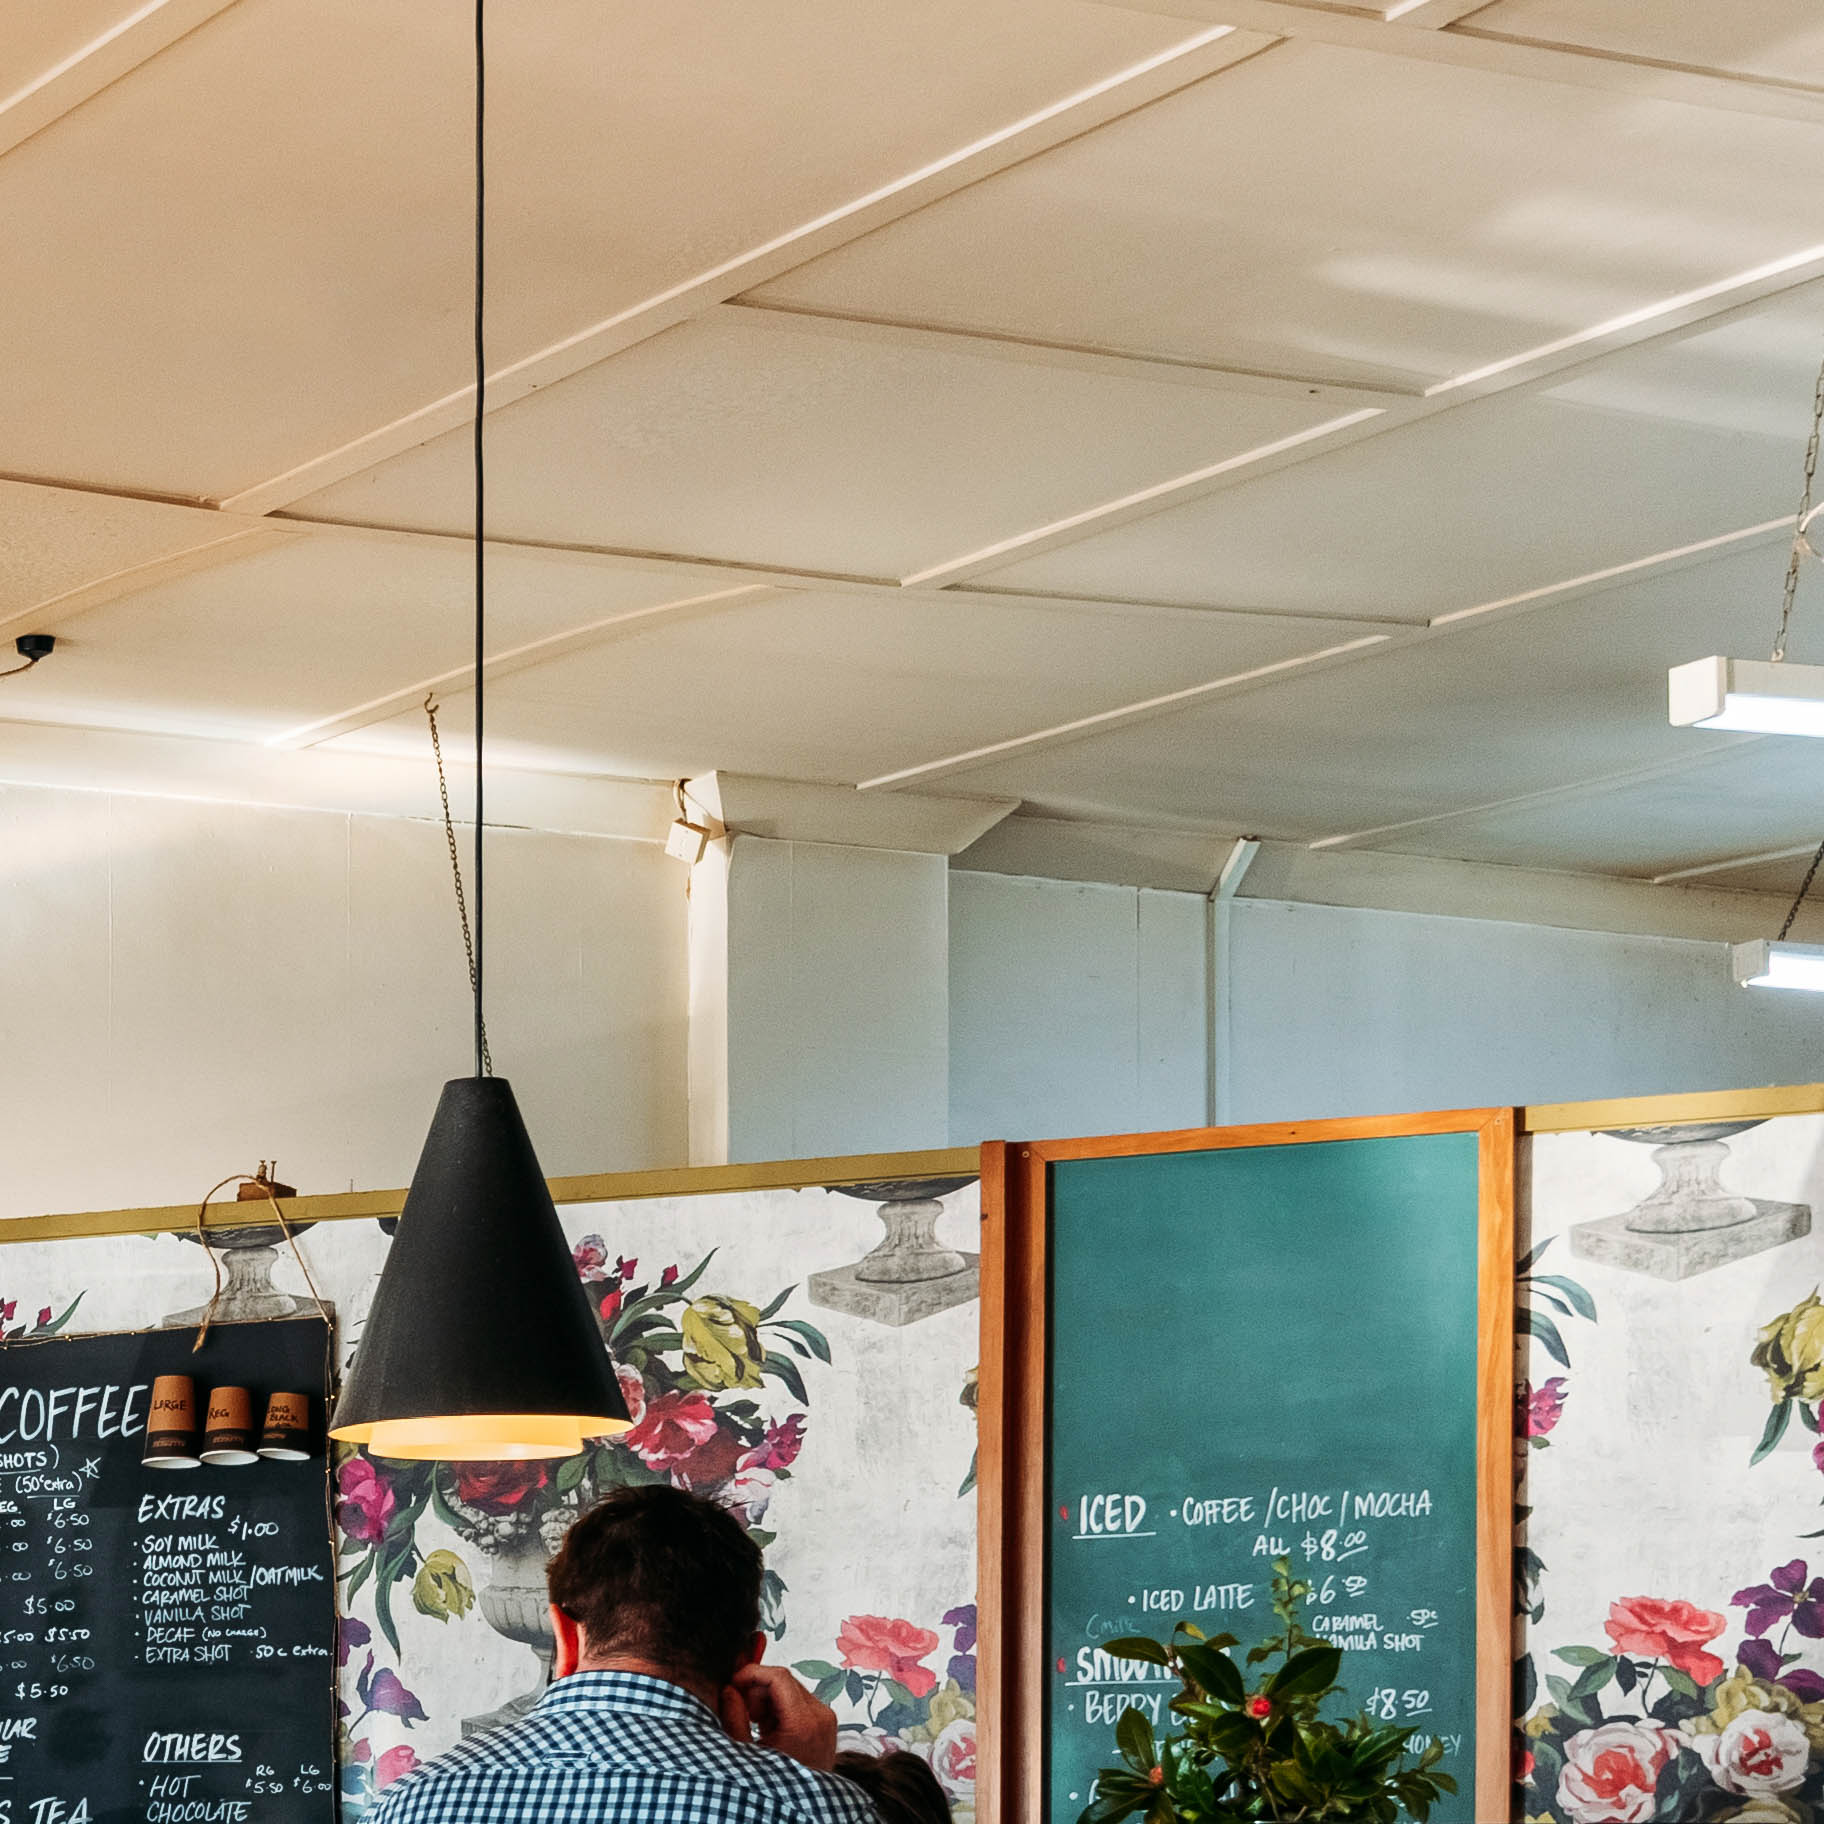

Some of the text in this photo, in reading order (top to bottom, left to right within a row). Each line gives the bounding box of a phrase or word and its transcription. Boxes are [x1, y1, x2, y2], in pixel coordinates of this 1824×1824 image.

[53, 1498, 76, 1510] LG
[138, 1494, 226, 1522] EXTRAS
[1078, 1490, 1432, 1533] ICED COFFEE MOCHA
[228, 1515, 280, 1540] $1.00
[142, 1534, 219, 1553] SOY MILK
[1252, 1534, 1290, 1555] ALL
[144, 1554, 202, 1570] ALMOND
[144, 1570, 205, 1587] COCONUT
[23, 1595, 76, 1616] $5.00
[142, 1587, 210, 1605] CARAMEL
[1142, 1584, 1254, 1610] ICED LATTE
[145, 1606, 206, 1626] VANILLA
[147, 1627, 196, 1643] DECAF
[1384, 1634, 1425, 1651] SHOT
[146, 1647, 190, 1664] EXTRA
[143, 1732, 242, 1761] OTHERS
[149, 1776, 201, 1799] HOT
[147, 1801, 251, 1824] CHOCOLATE
